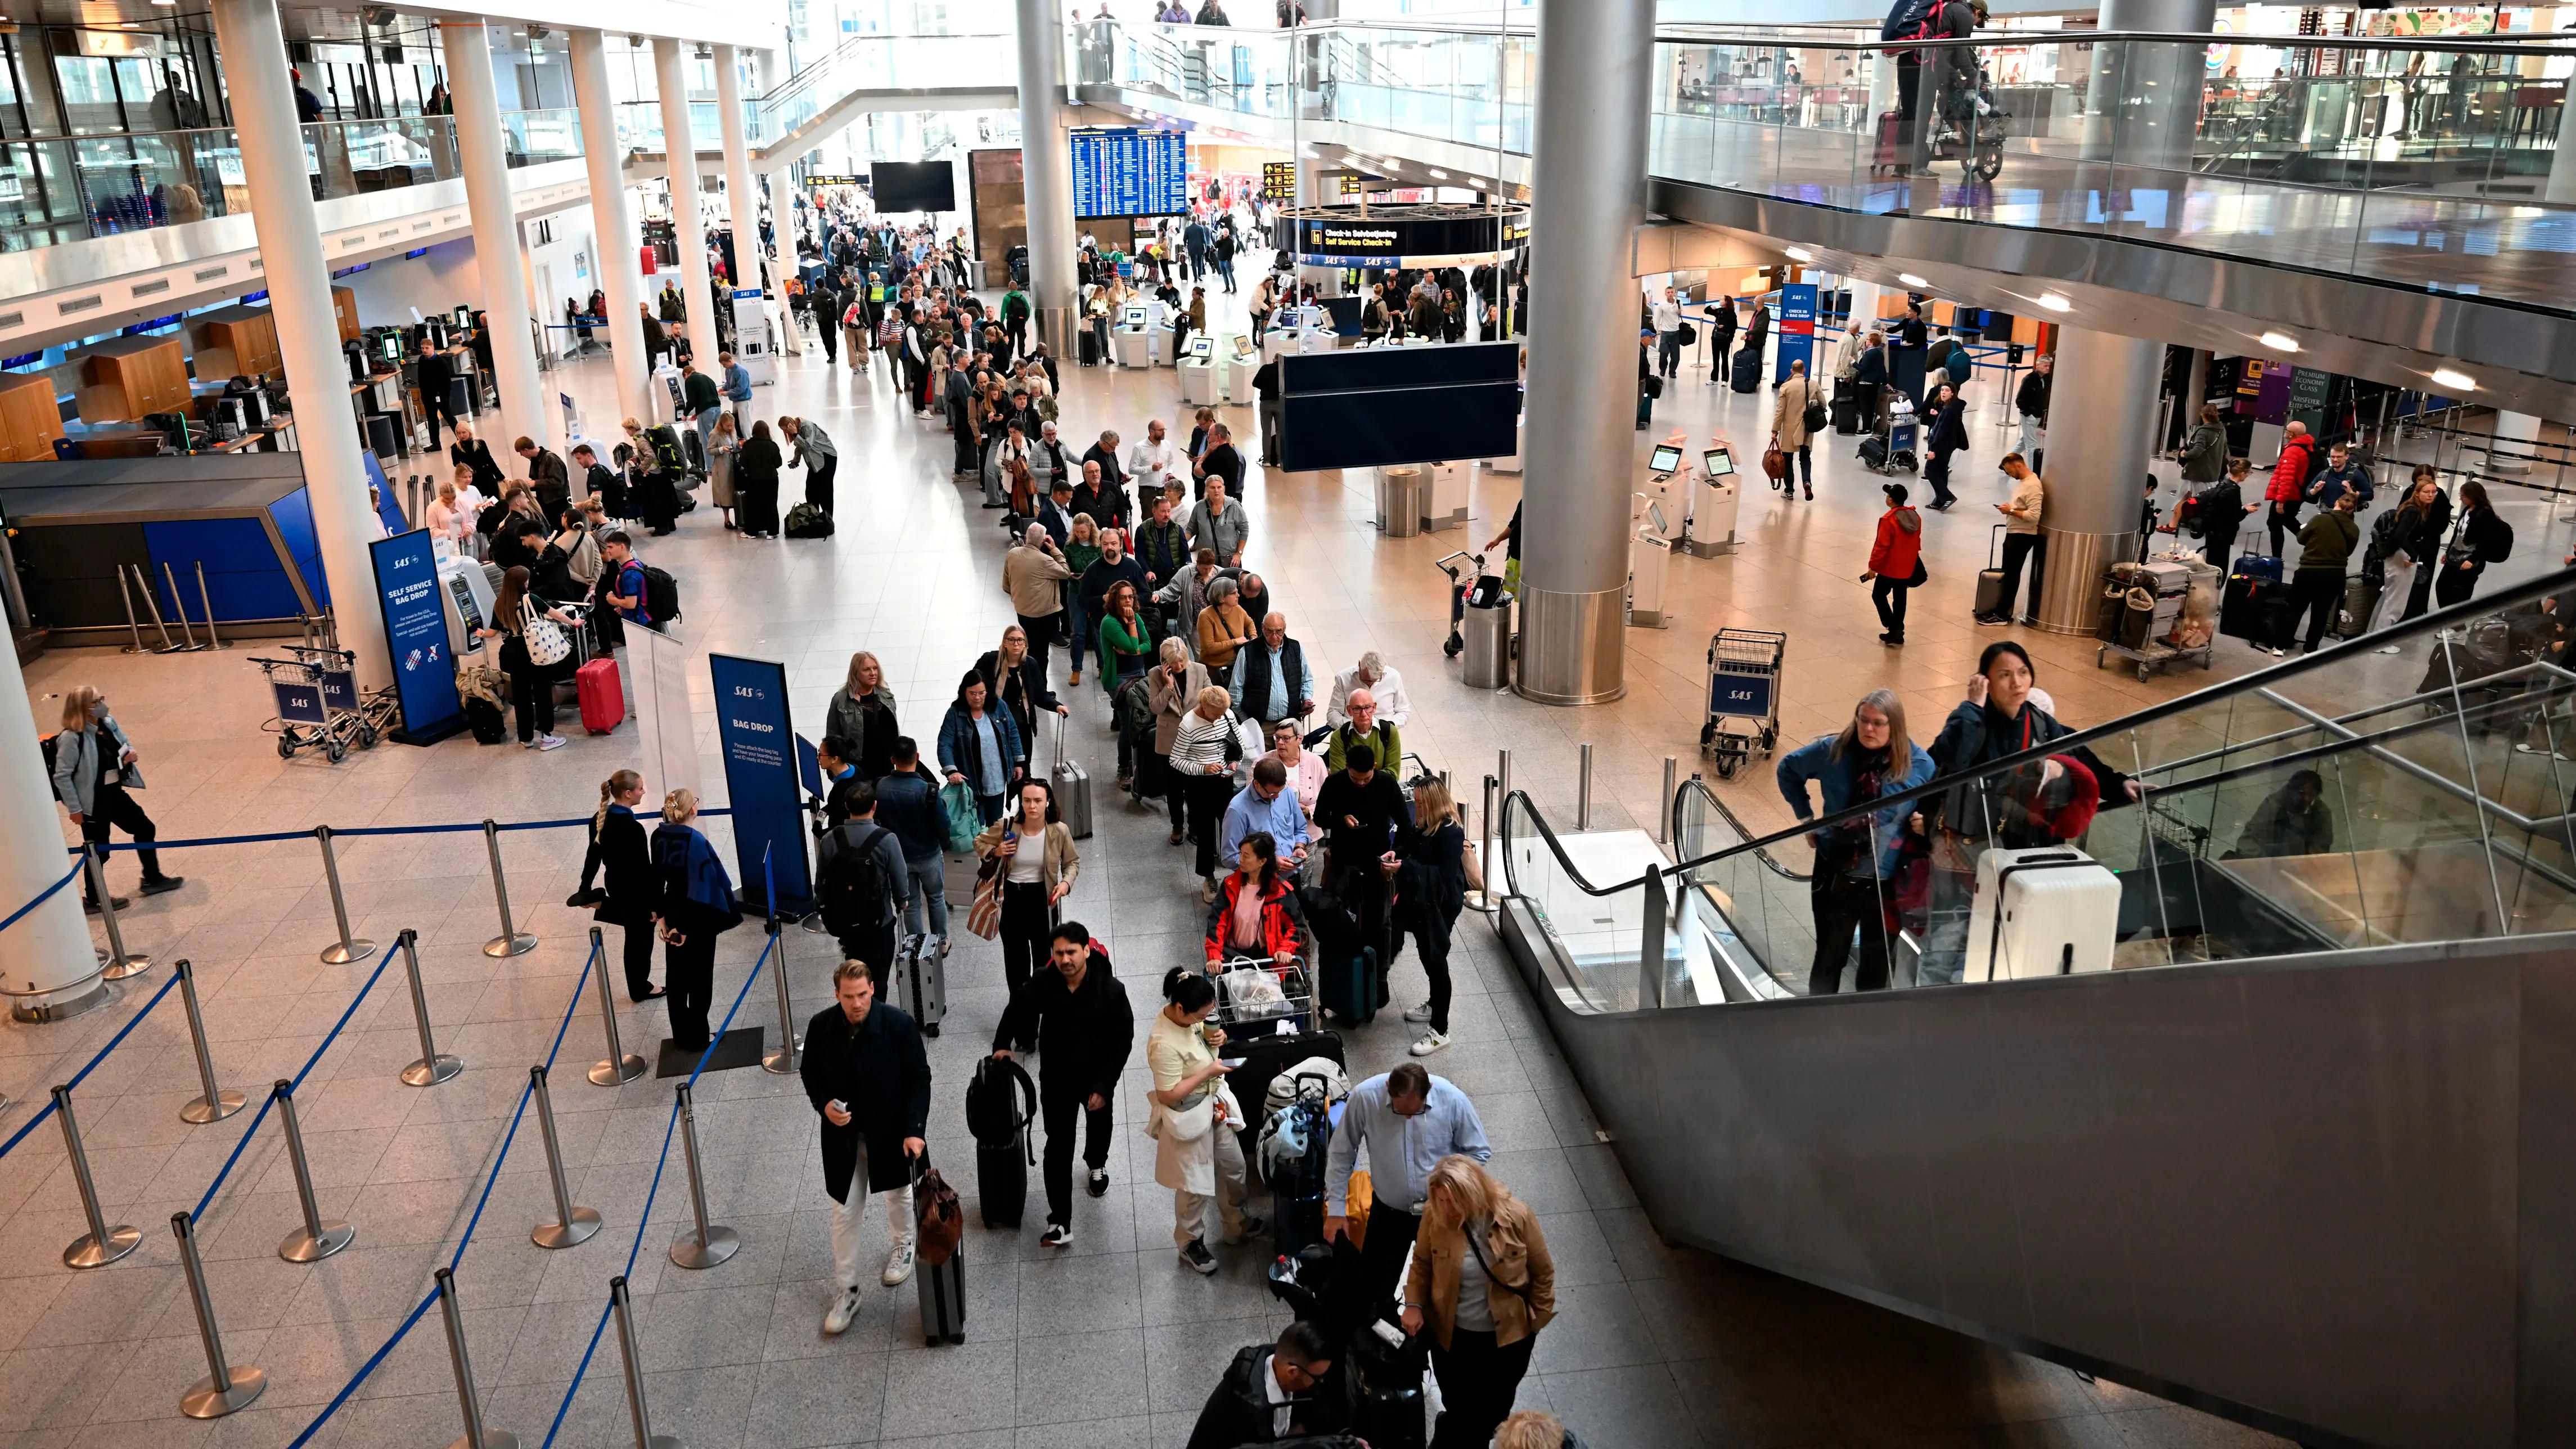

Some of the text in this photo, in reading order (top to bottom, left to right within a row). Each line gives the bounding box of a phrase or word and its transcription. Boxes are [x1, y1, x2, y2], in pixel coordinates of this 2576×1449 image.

[1324, 256, 1339, 264] SAS
[1363, 258, 1381, 266] SAS
[2298, 370, 2325, 379] PREMIUM
[2295, 376, 2325, 386] ECONOMY
[2293, 395, 2320, 405] KRISFLYER
[394, 557, 409, 569] SAS
[388, 579, 432, 598] SELF SERVICE
[395, 590, 429, 605] BAG DROP
[324, 685, 341, 694] SAS
[733, 686, 753, 698] SAS
[1728, 690, 1753, 700] SAS
[291, 698, 308, 708] SAS
[733, 719, 773, 733] BAG DROP
